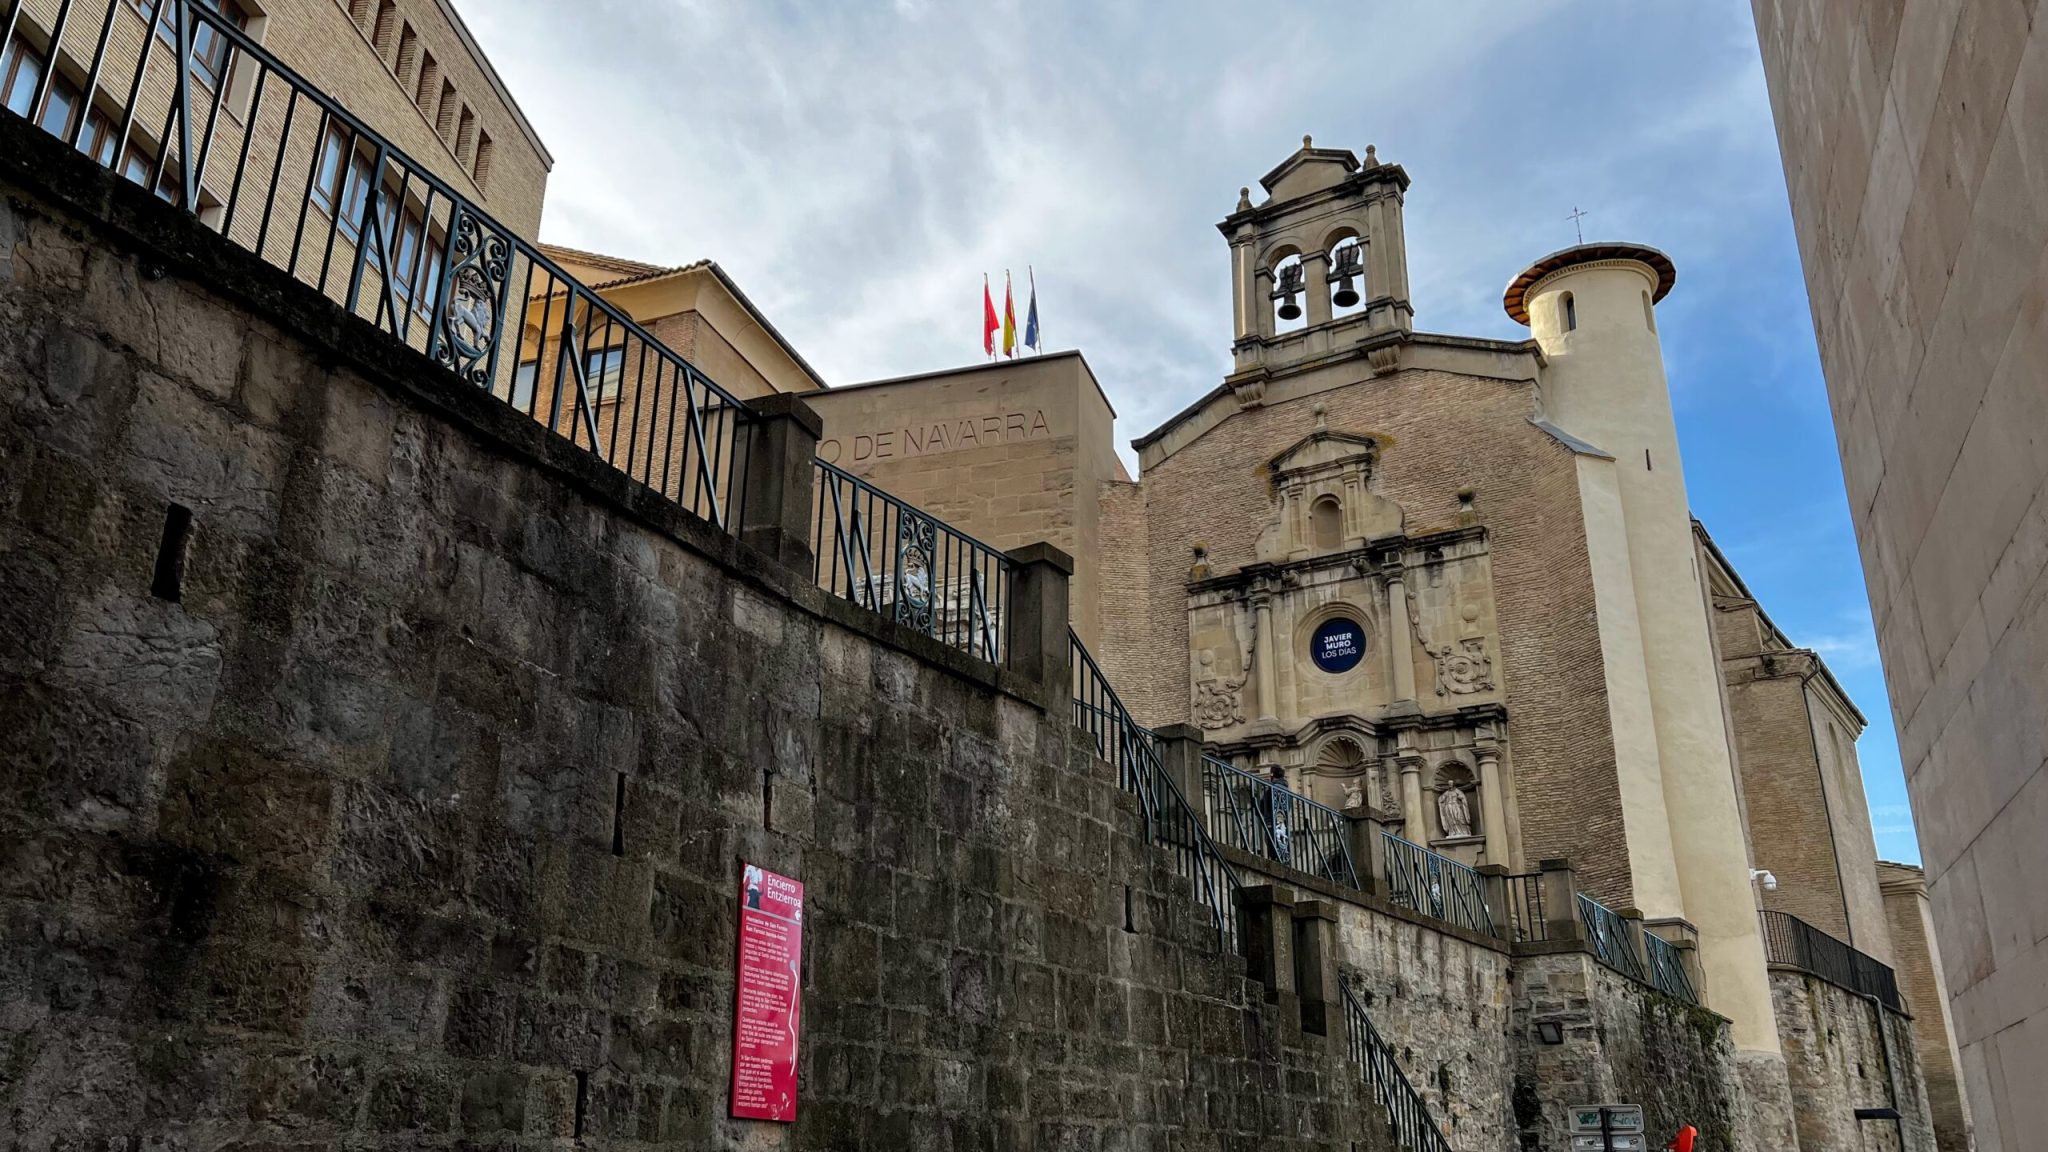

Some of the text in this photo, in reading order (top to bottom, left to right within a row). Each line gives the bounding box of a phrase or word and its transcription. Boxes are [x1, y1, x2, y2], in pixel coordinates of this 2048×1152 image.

[854, 431, 894, 461] DE
[904, 409, 1050, 455] NAVARRA
[1324, 633, 1352, 643] JAVIER
[1326, 640, 1351, 650] MURO
[1321, 646, 1357, 659] LOS DÍAS
[767, 874, 796, 893] Encierro
[767, 889, 801, 908] Entzierroa
